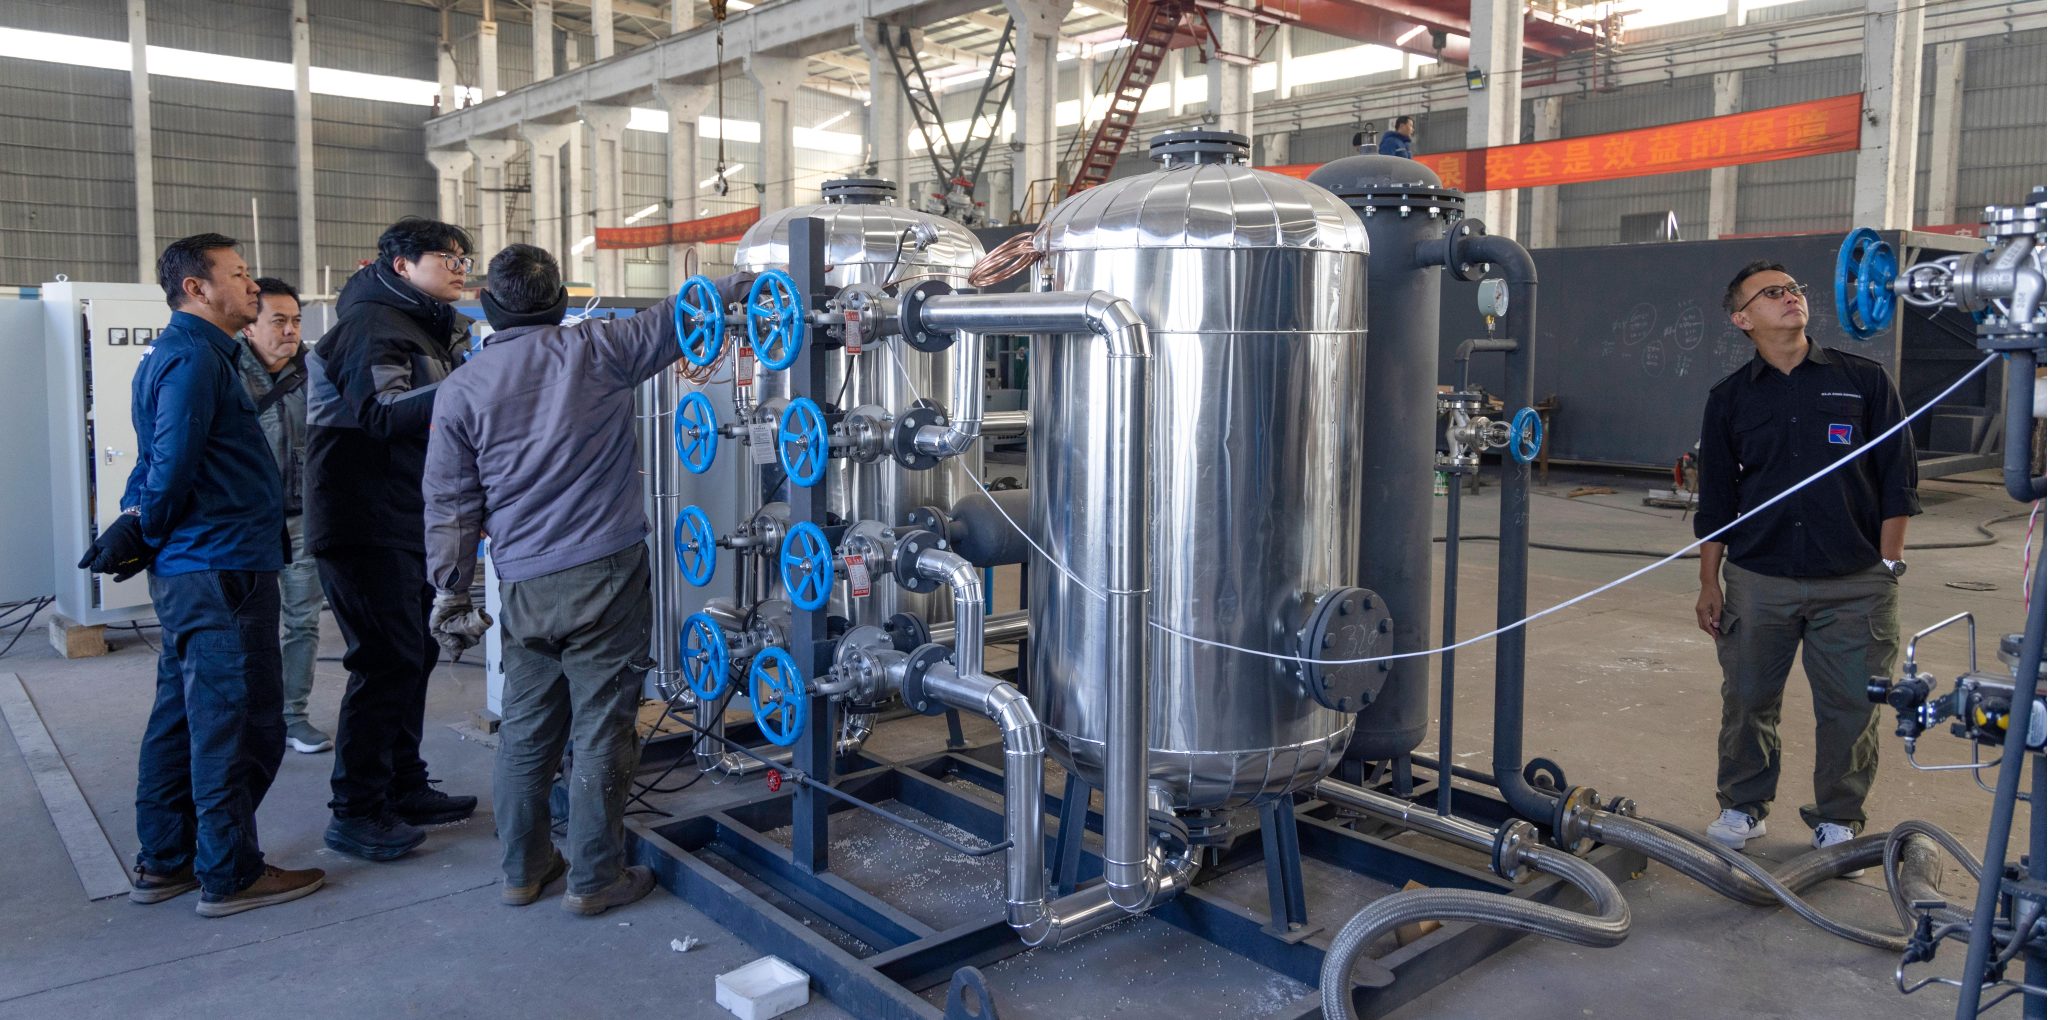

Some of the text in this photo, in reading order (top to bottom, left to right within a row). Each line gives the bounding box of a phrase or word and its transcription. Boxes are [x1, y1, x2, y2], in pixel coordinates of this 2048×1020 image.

[1485, 109, 1829, 182] 安全是效益的保障
